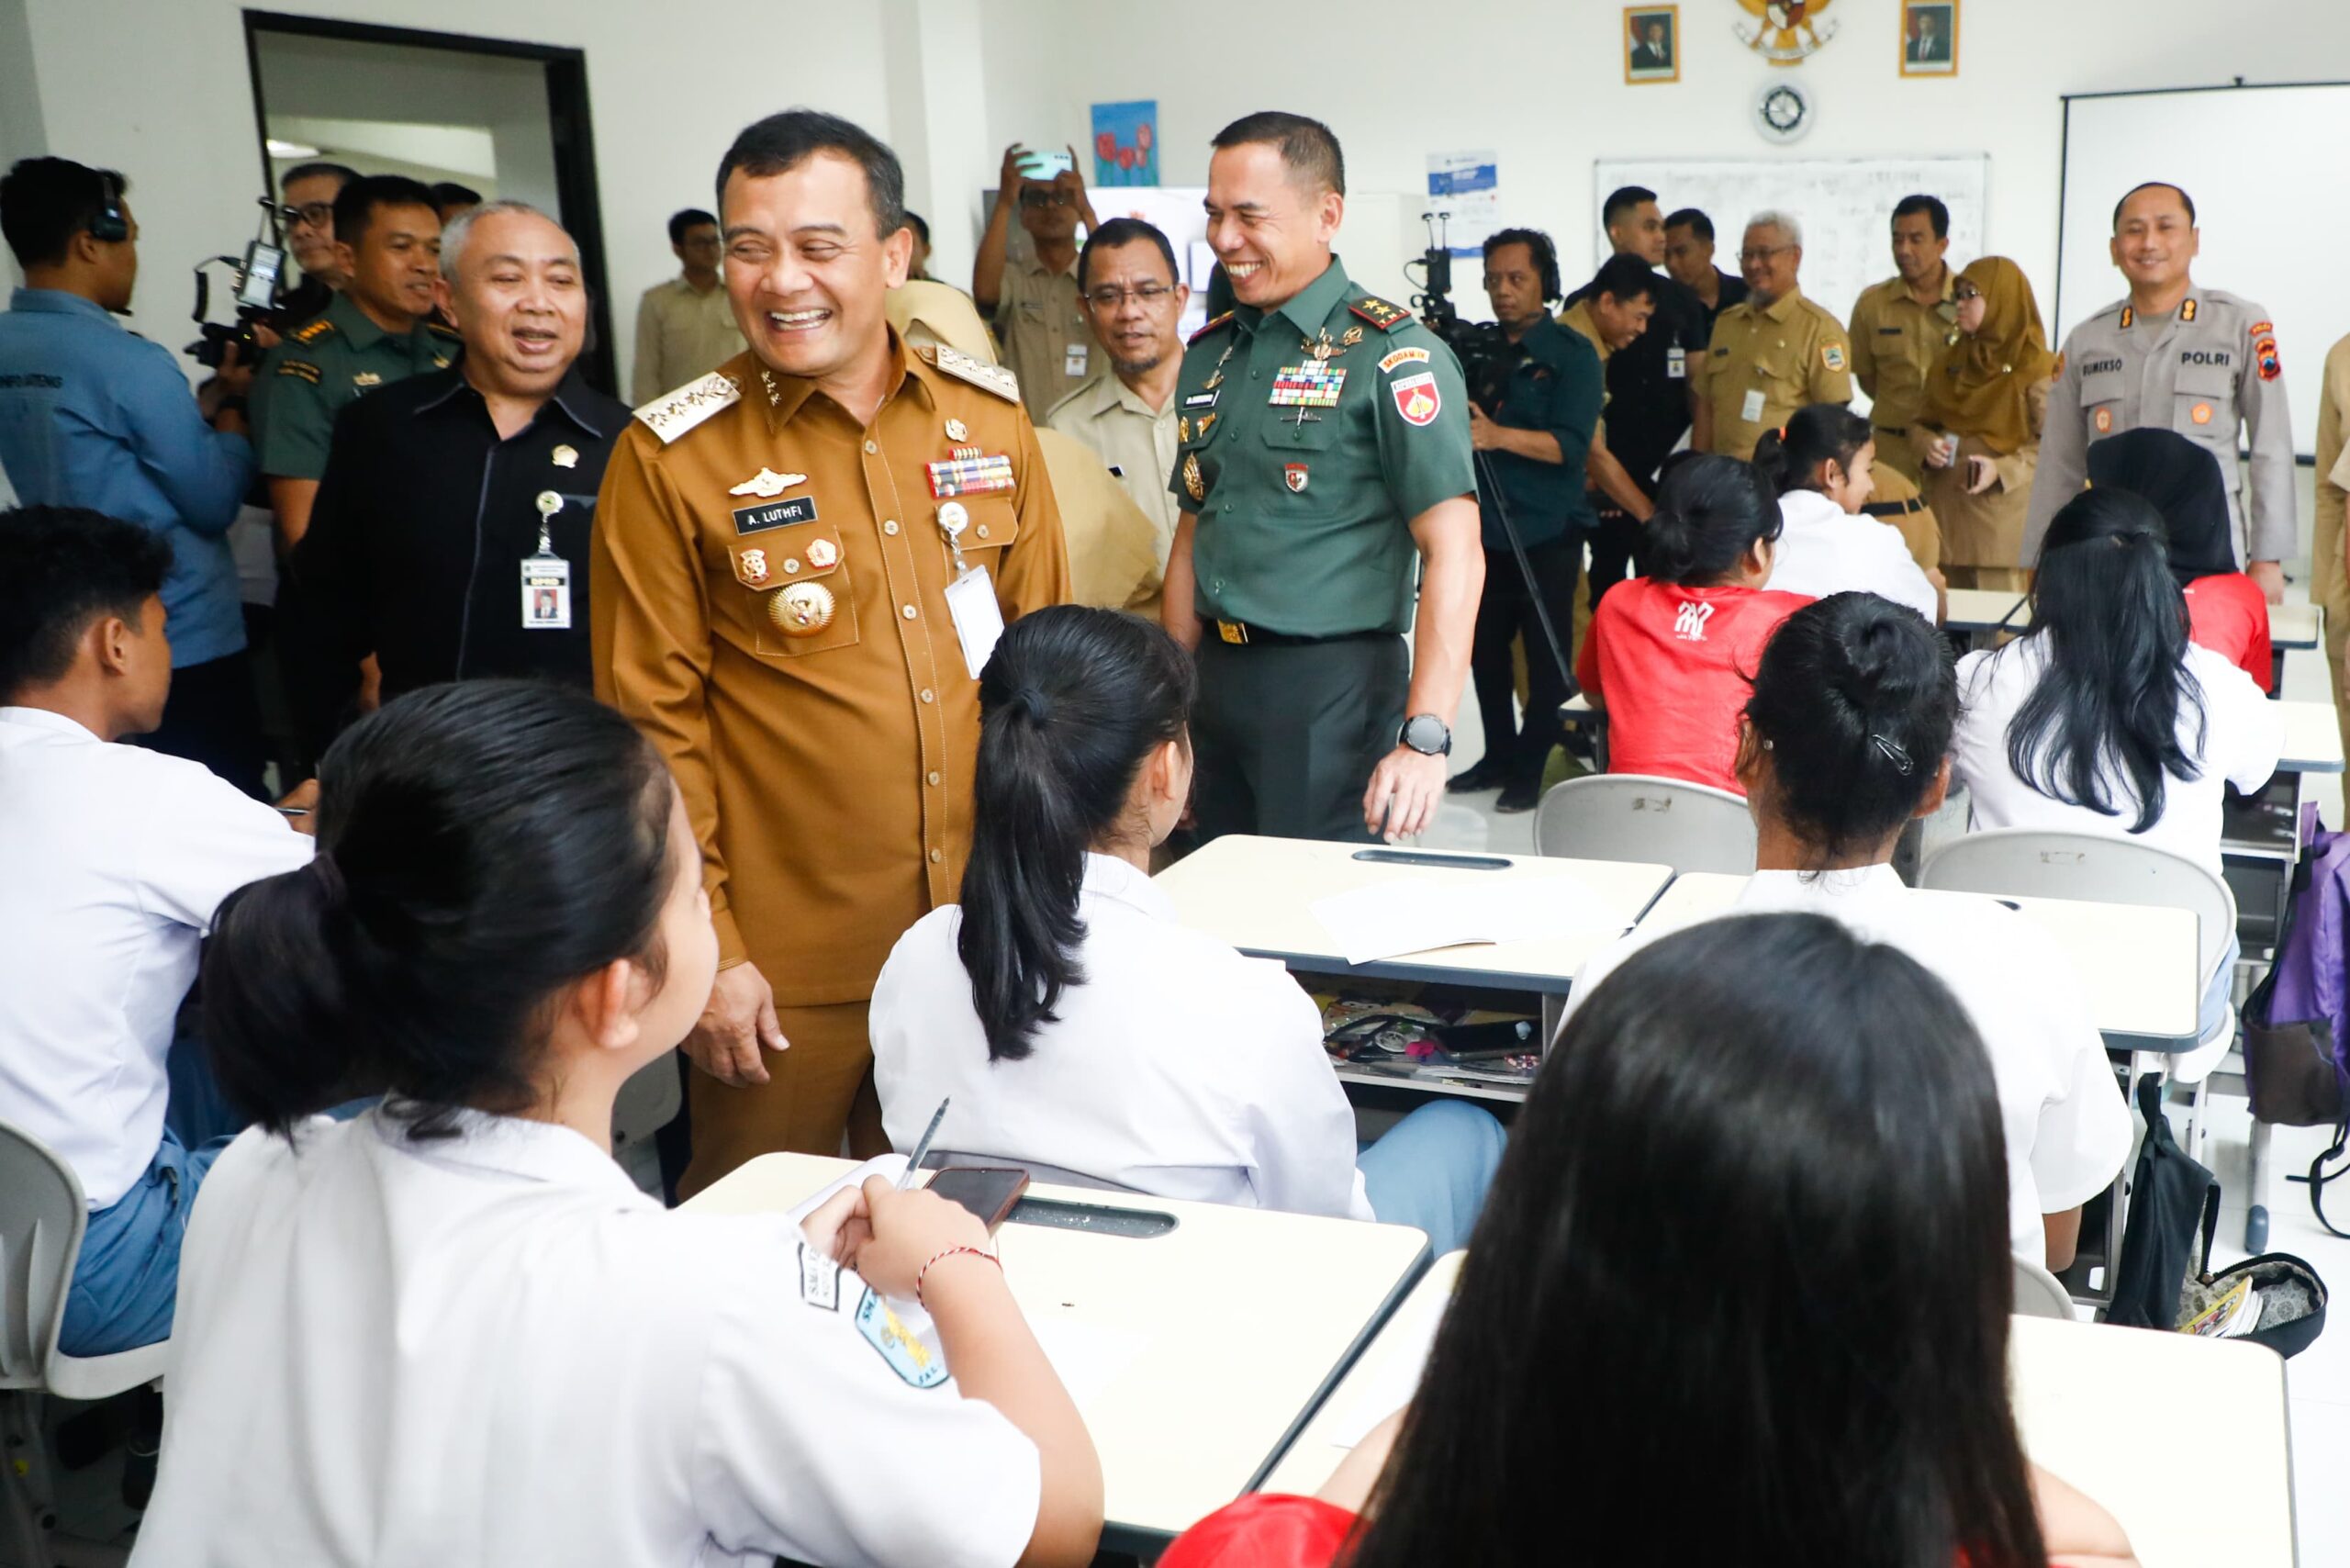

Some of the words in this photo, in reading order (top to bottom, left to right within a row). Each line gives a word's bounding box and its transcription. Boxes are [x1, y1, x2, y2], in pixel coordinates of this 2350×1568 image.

[2181, 352, 2231, 366] POLRI
[748, 514, 761, 526] A.
[762, 505, 803, 523] LUTHFI
